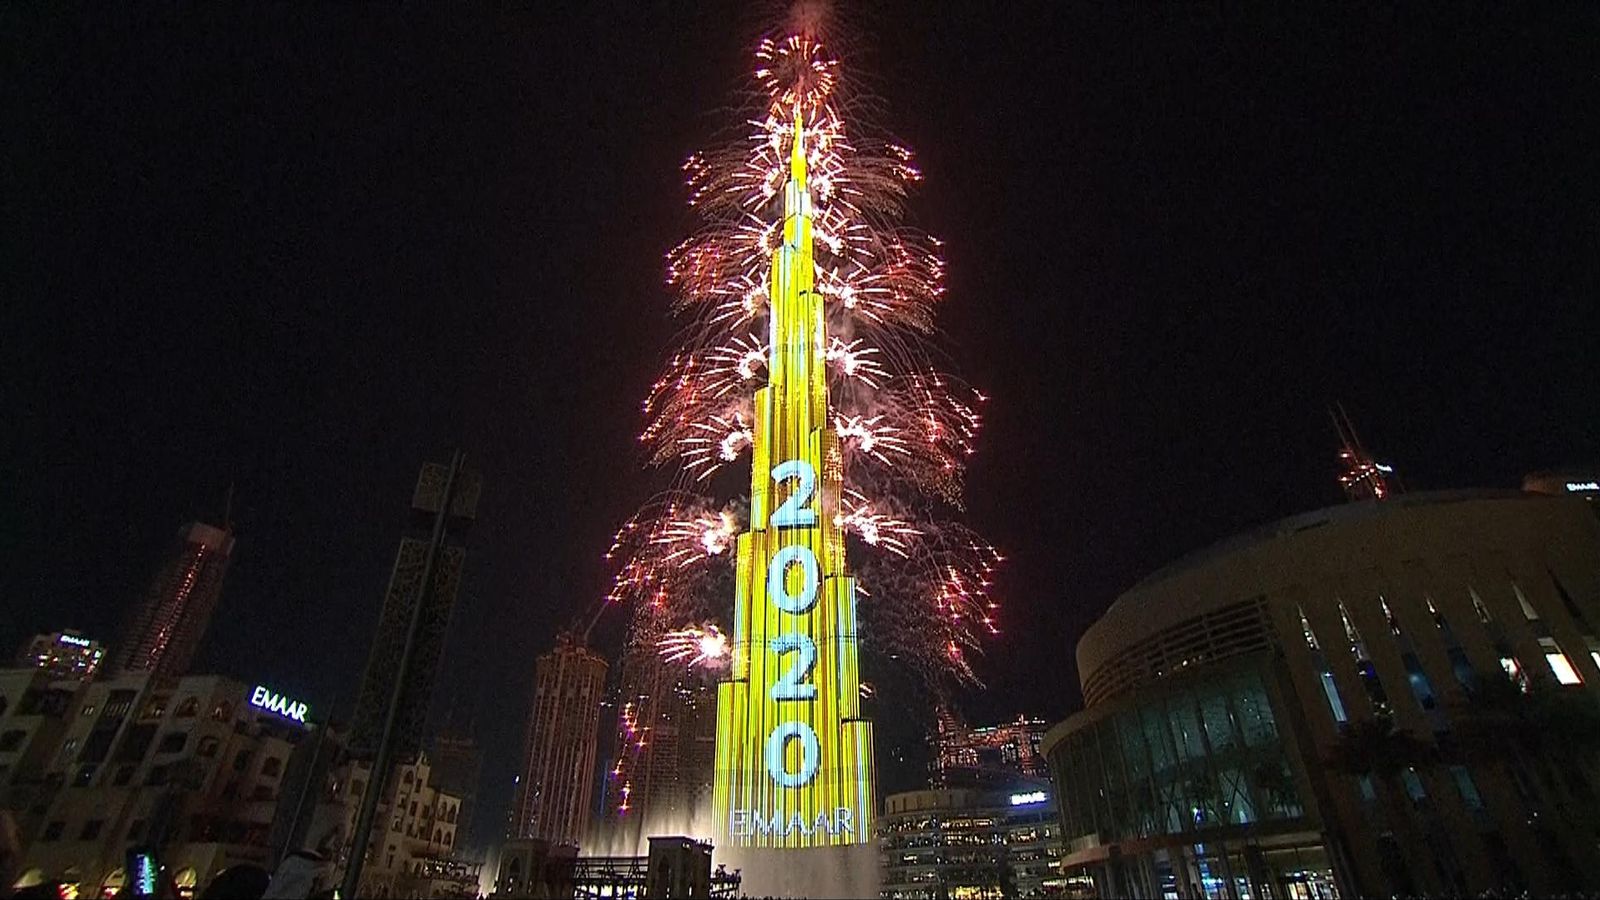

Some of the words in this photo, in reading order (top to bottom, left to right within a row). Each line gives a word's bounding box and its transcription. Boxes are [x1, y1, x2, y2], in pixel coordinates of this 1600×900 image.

[765, 459, 821, 788] 2020
[251, 685, 308, 723] EMAAR
[729, 807, 854, 836] EMAAR
